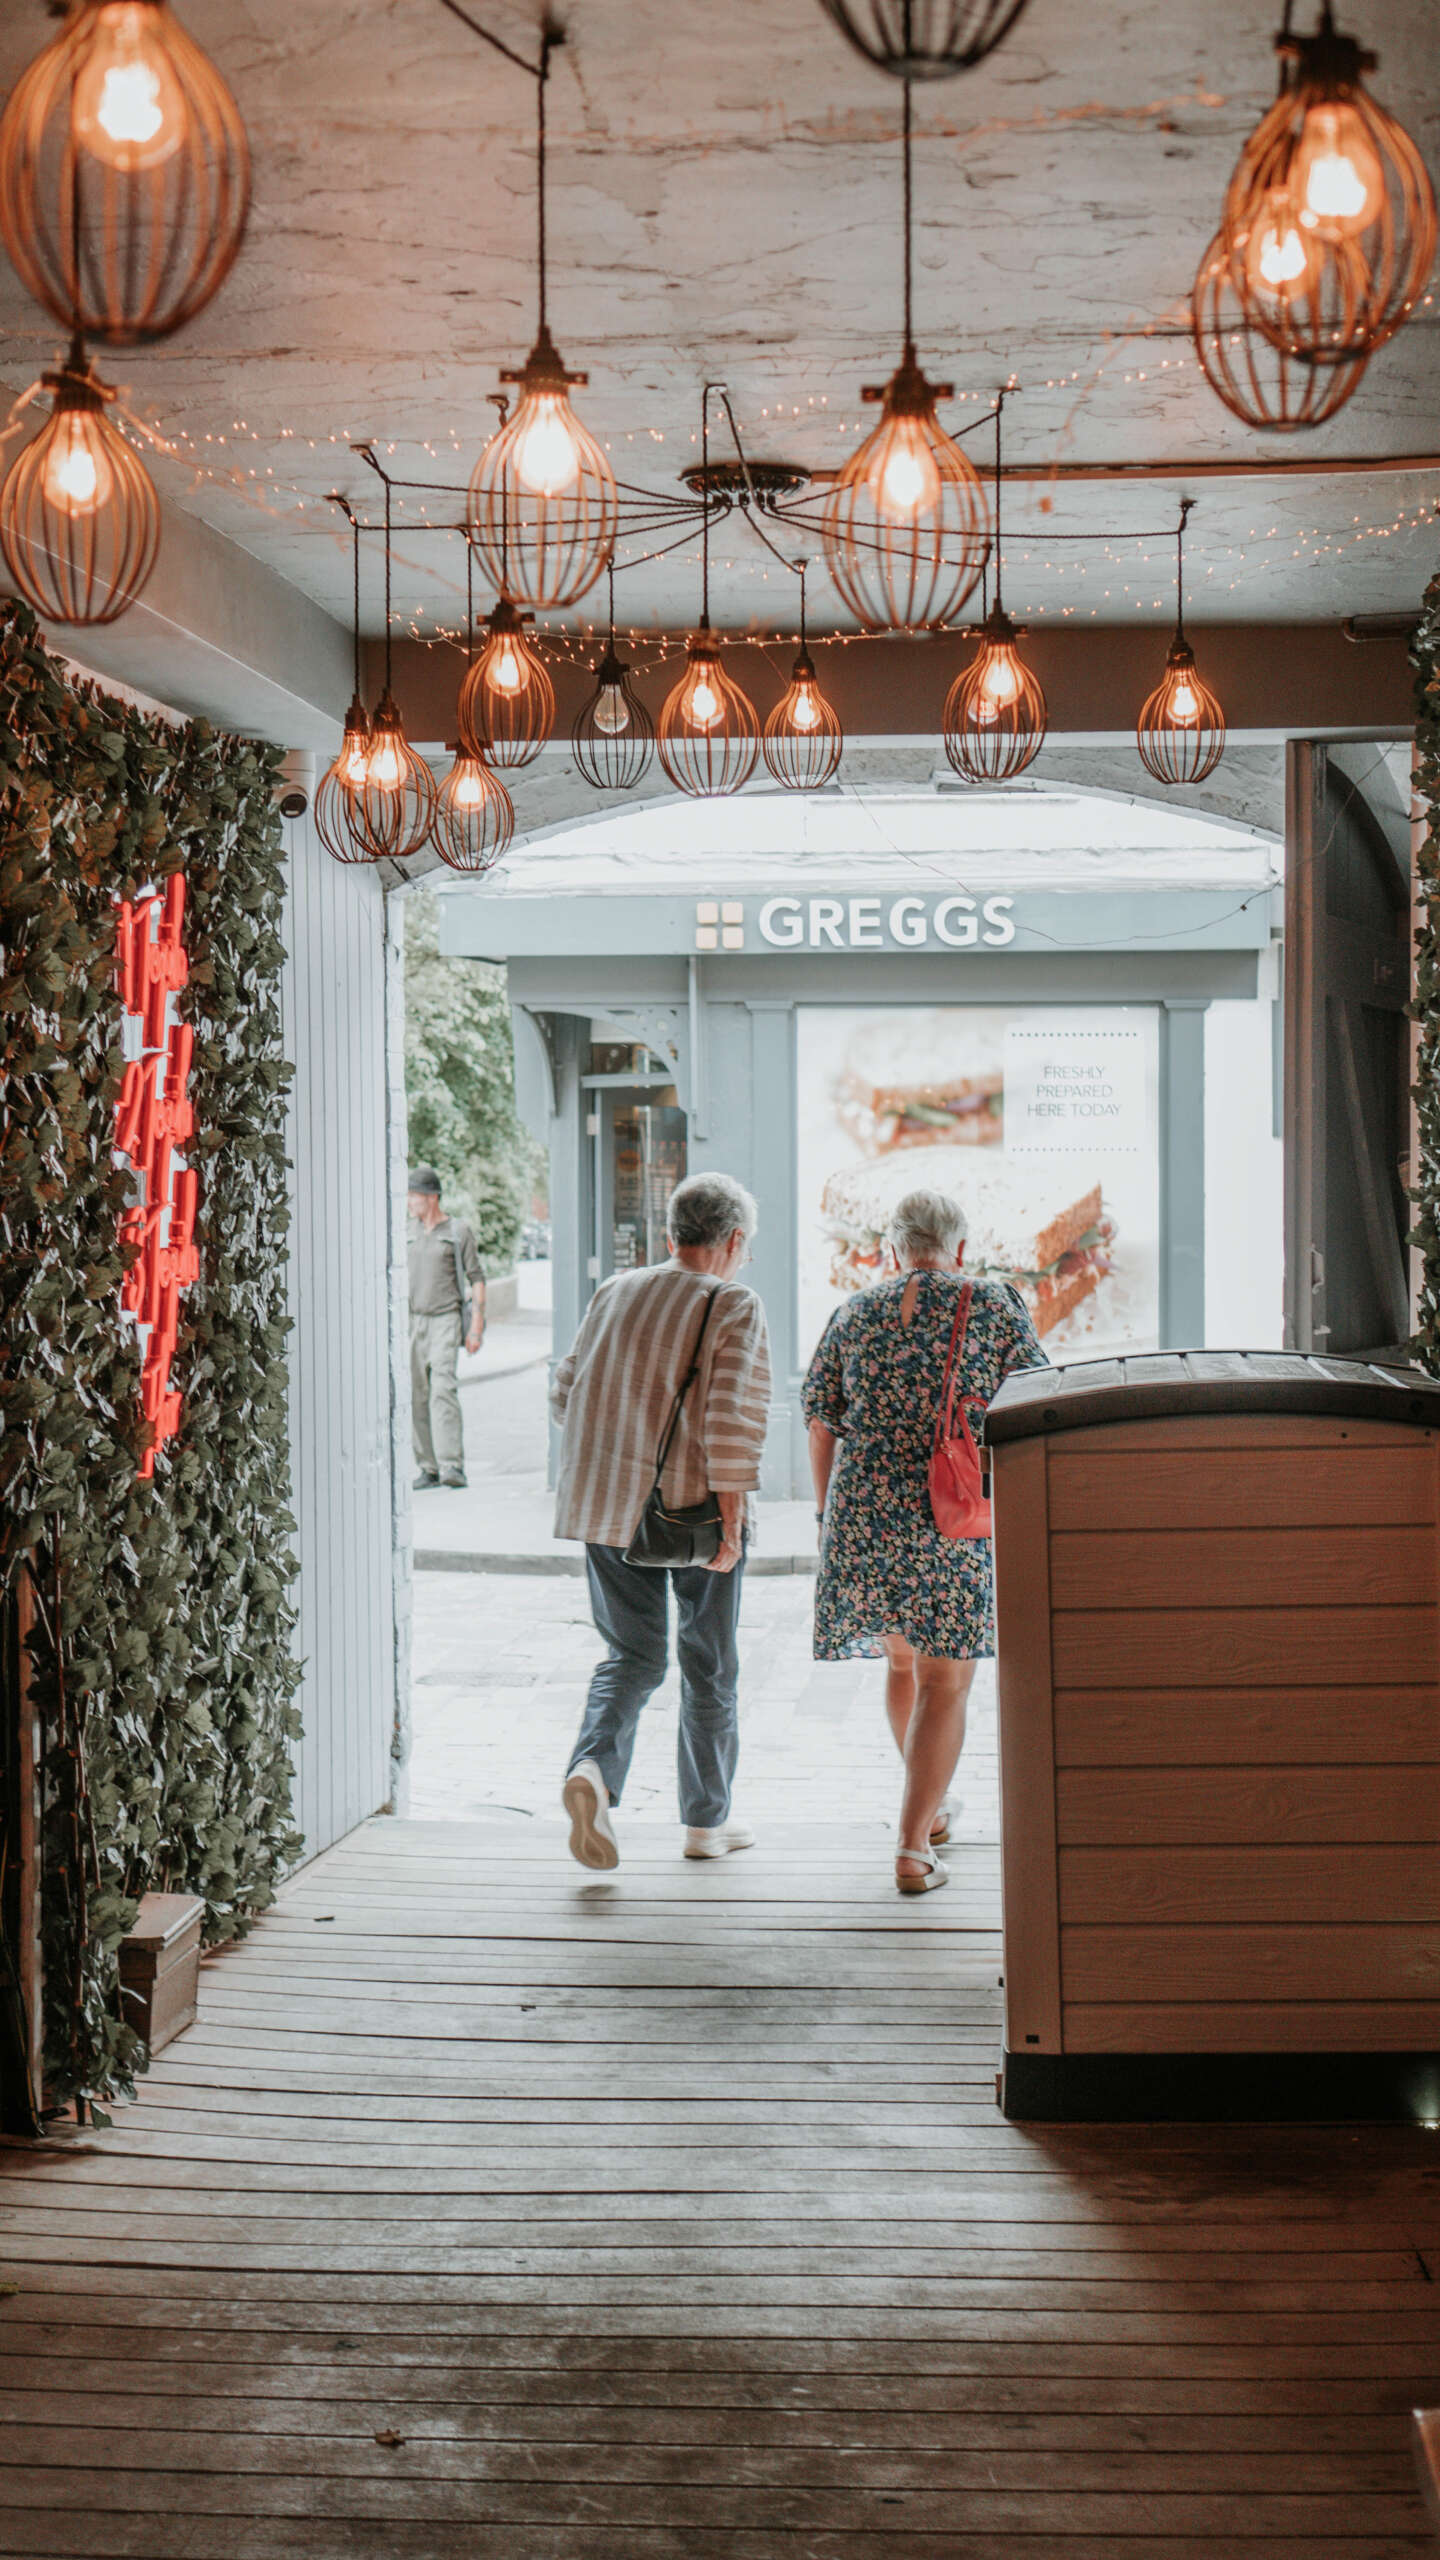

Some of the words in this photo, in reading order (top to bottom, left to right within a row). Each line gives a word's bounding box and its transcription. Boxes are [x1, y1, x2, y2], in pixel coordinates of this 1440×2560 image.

[759, 897, 1016, 946] GREGGS
[1043, 1065, 1105, 1079] FRESHLY
[1036, 1084, 1113, 1098] PREPARED
[1027, 1103, 1066, 1117] HERE
[1072, 1103, 1122, 1116] TODAY
